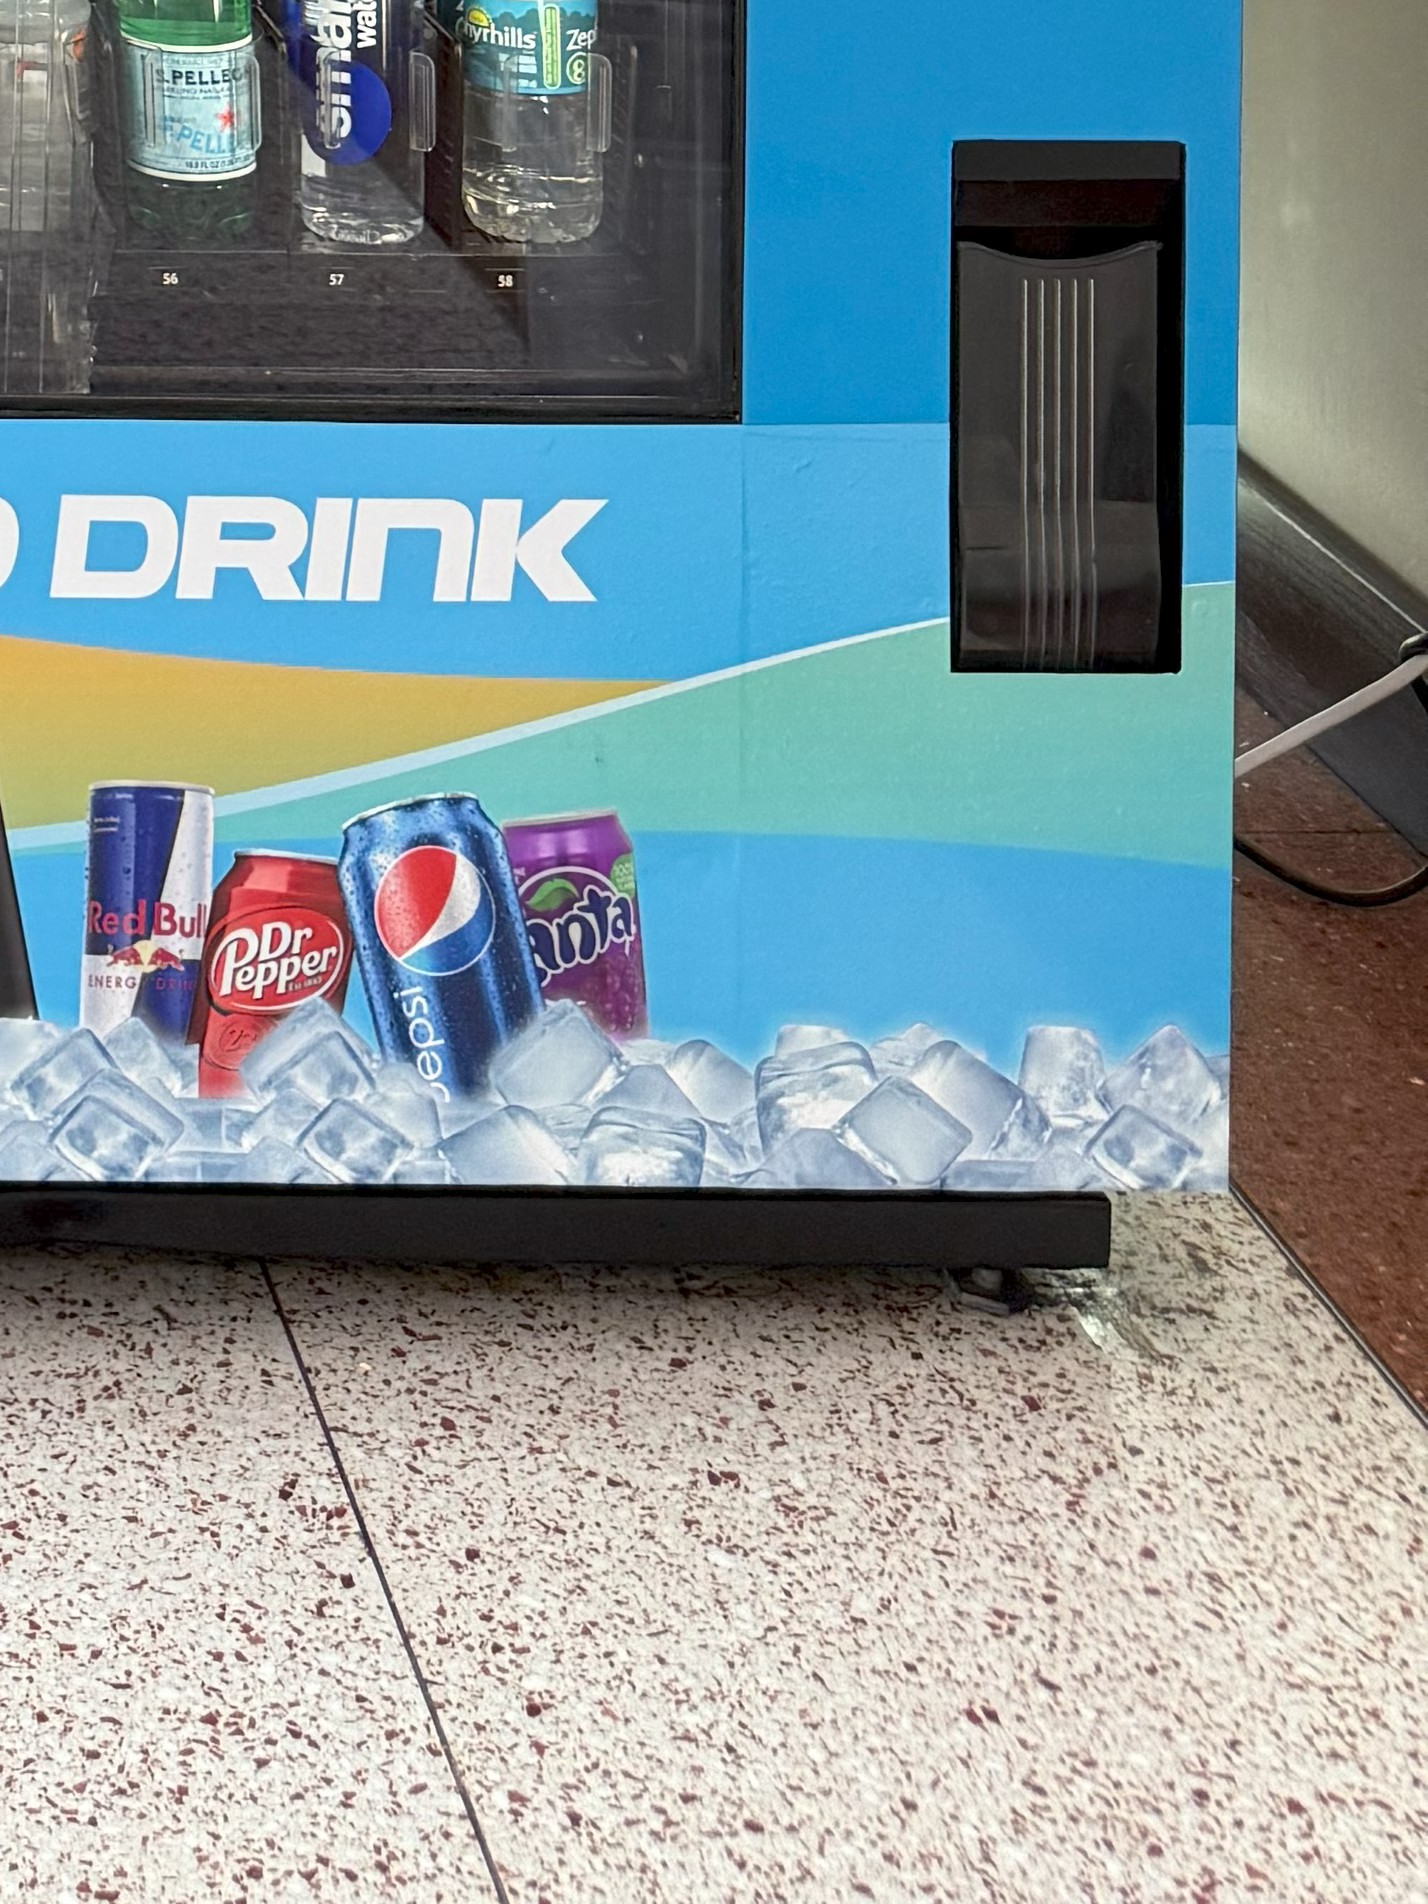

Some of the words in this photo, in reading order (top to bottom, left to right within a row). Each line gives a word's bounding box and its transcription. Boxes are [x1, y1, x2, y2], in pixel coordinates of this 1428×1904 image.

[163, 273, 179, 286] 56
[329, 273, 344, 285] 57
[498, 274, 513, 286] 58
[50, 494, 609, 603] DRINK
[88, 904, 146, 936] Red
[153, 904, 206, 937] Bull
[259, 926, 312, 957] Dr
[219, 944, 336, 996] Pepper
